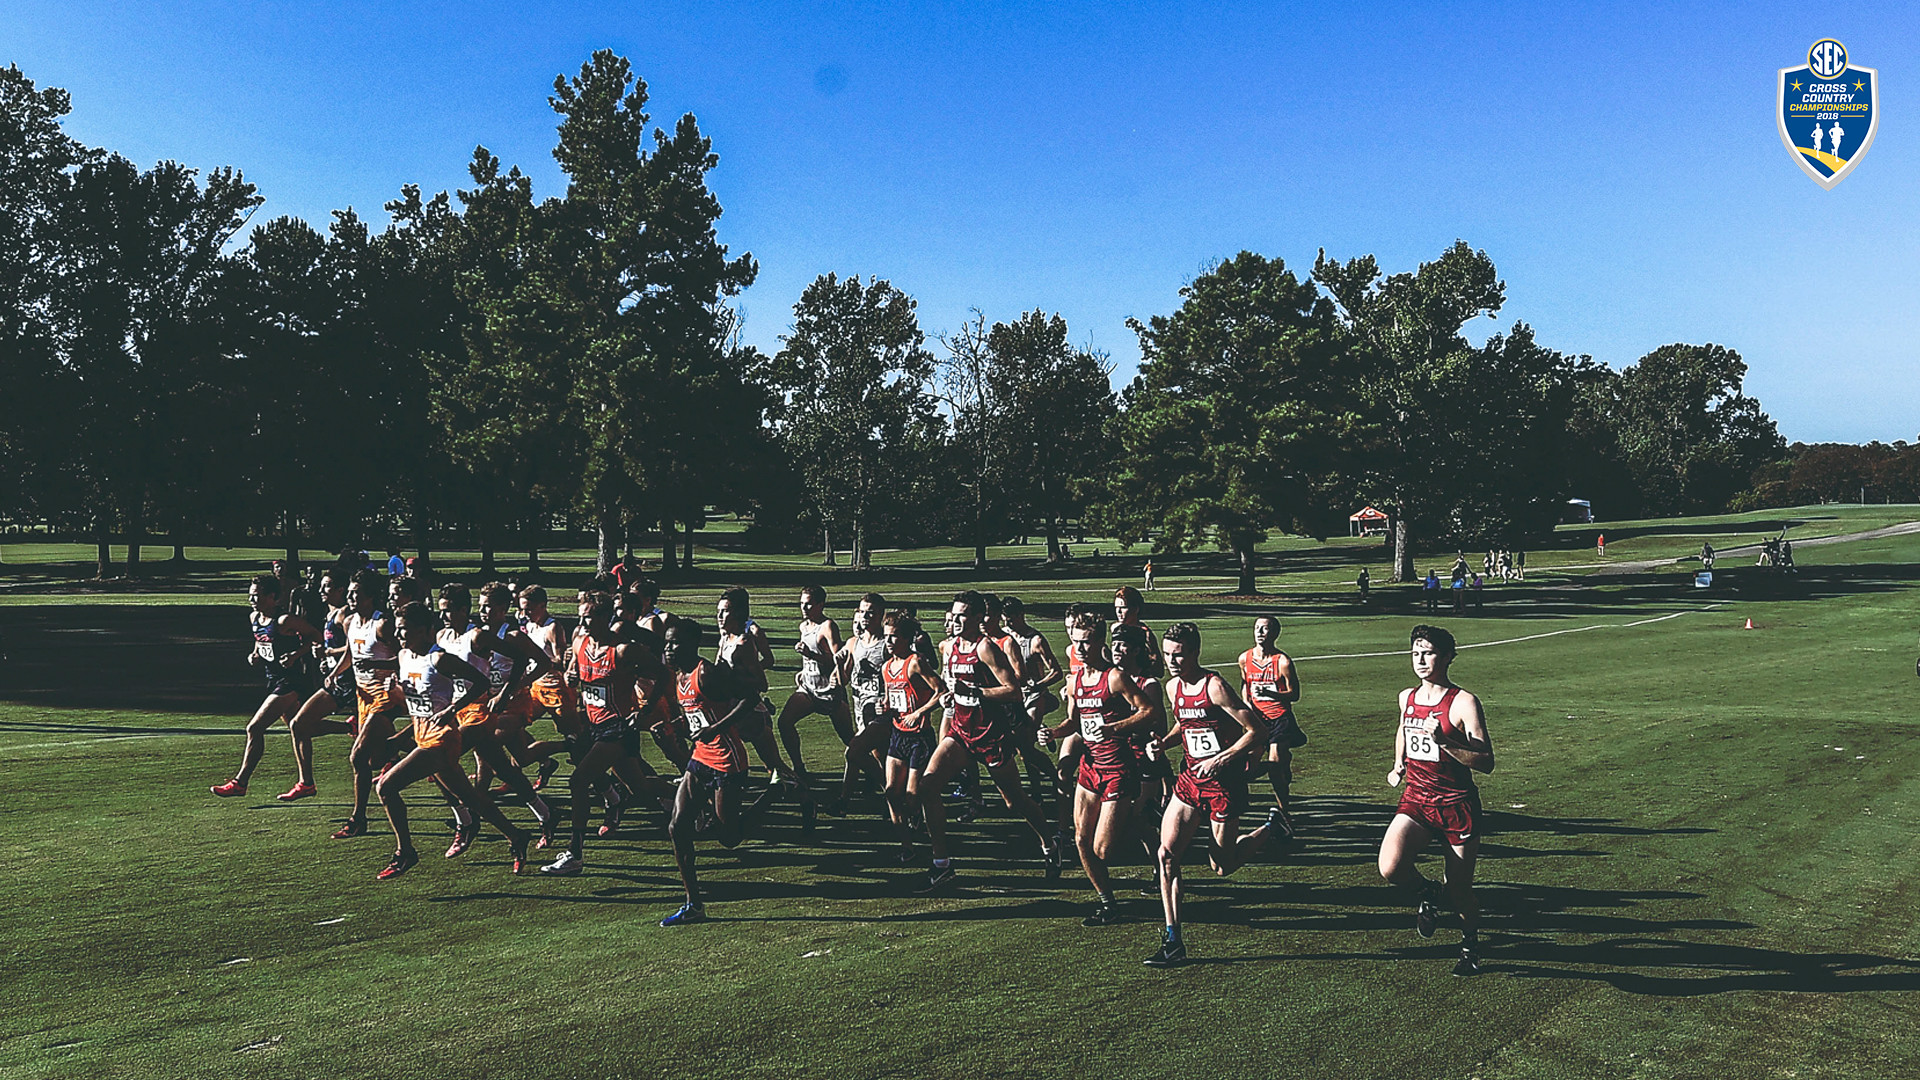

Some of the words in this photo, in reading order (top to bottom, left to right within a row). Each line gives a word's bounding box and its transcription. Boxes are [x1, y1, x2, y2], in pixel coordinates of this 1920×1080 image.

[354, 639, 366, 653] T
[408, 672, 422, 689] T
[1191, 736, 1211, 751] 75
[1410, 735, 1431, 754] 85
